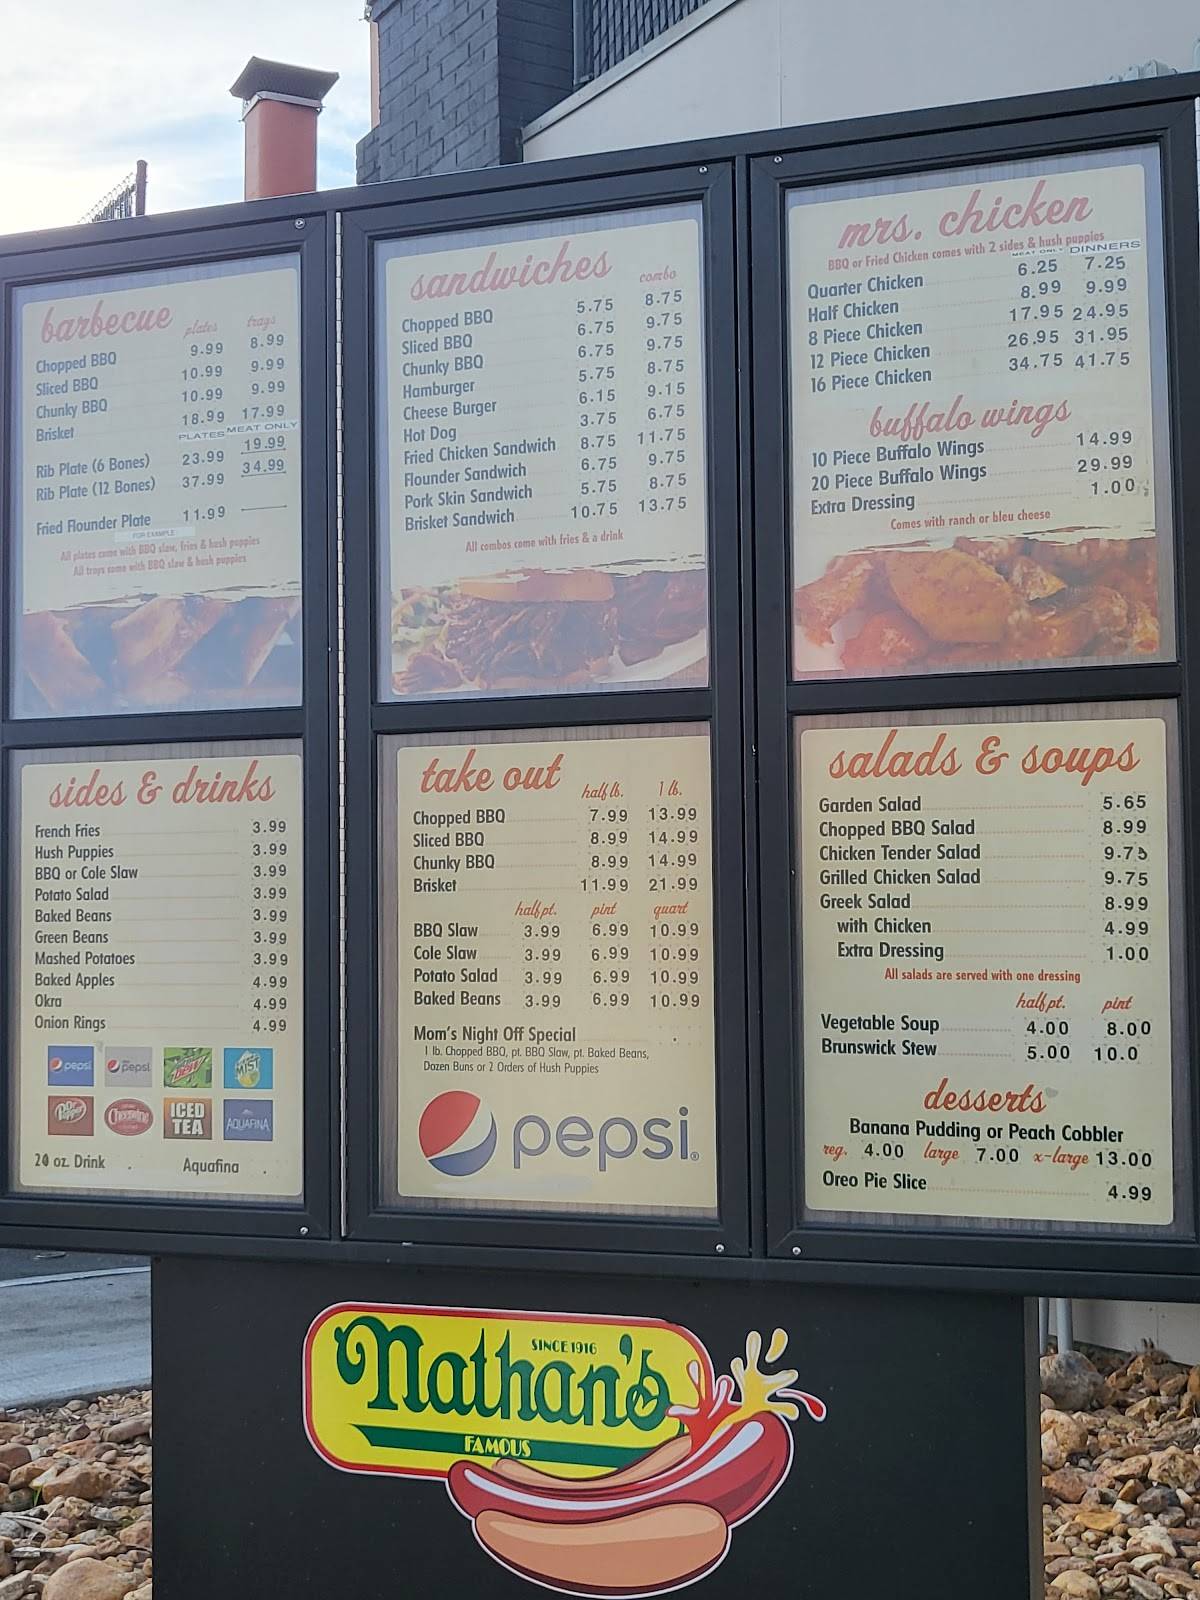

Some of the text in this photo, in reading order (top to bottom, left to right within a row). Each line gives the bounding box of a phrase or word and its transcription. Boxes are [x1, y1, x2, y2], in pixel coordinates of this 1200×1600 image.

[838, 180, 1094, 249] mrs. chicken
[828, 231, 1104, 271] BBQ or Fried Chicken comes with 2 sides & hush puppies
[1070, 240, 1141, 254] DINNERS
[410, 240, 613, 301] sandwiches
[639, 268, 676, 283] combo
[808, 256, 1125, 299] Quarter Chicken 6.25 7.25
[42, 300, 173, 343] barbecue
[402, 290, 682, 334] Chopped BBQ 5.75 8.75
[183, 320, 218, 338] plates
[36, 404, 284, 442] Brisket 18.99 17.99
[870, 395, 1071, 442] buffalo wings
[179, 431, 225, 440] PLATES
[265, 422, 297, 430] ONLY
[404, 428, 685, 464] Fried Chicken Sandwich 8.75 11.75
[813, 431, 1131, 467] 10 Piece Buffalo Wings 14.99
[36, 459, 285, 501] Rib Plate (12 Bones) 37.99 34.99
[891, 509, 1050, 530] Comes with ranch or bleu cheese
[60, 551, 71, 562] All
[73, 550, 96, 562] plates
[98, 550, 117, 558] come
[120, 544, 136, 556] with
[139, 543, 156, 555] BBQ
[180, 541, 197, 551] fries
[200, 539, 207, 549] &
[209, 537, 227, 548] hush
[229, 536, 260, 549] puppies
[466, 541, 477, 552] All
[481, 539, 511, 551] combos
[514, 540, 535, 549] come
[538, 534, 556, 546] with
[560, 533, 579, 545] fries
[582, 532, 589, 543] &
[601, 528, 623, 541] drink
[829, 729, 1140, 786] salads & soups
[421, 749, 564, 793] take out
[49, 760, 276, 808] sides & drinks
[581, 780, 682, 801] half lb. 1 lb.
[413, 808, 696, 828] Chopped BBQ 7.99 13.99
[35, 820, 286, 838] French Fries 3.99
[35, 864, 286, 880] BBQ or Cole Slaw 3.99
[820, 868, 1148, 886] Grilled Chicken Salad 9.75
[515, 899, 688, 920] half pt. pint quart
[885, 968, 1080, 983] All salads are served with one dressing
[35, 1015, 286, 1032] Onion Rings 4.99
[414, 1026, 575, 1045] Mom's Night Off Special
[64, 1061, 91, 1072] pepsi
[121, 1061, 151, 1073] pepsi
[236, 1060, 258, 1074] MIST
[424, 1061, 449, 1071] Dozen
[453, 1061, 473, 1071] Buns
[489, 1061, 493, 1072] 2
[497, 1062, 524, 1072] Orders
[528, 1062, 537, 1072] of
[540, 1062, 560, 1072] Hush
[565, 1063, 599, 1075] Puppies
[924, 1078, 1047, 1113] desserts
[170, 1102, 205, 1118] ICED
[172, 1119, 203, 1135] TEA
[226, 1118, 271, 1131] AQUAFINA
[513, 1106, 689, 1172] pepsi
[824, 1141, 1151, 1170] reg. 4.00 large 7.00 x-large 13.00
[183, 1158, 239, 1175] Aquafina
[823, 1170, 1151, 1201] Oreo Pie Slice 4.99
[531, 1338, 598, 1355] SINCE 1916
[333, 1315, 677, 1433] Nathan's
[463, 1435, 532, 1458] FAMOUS
